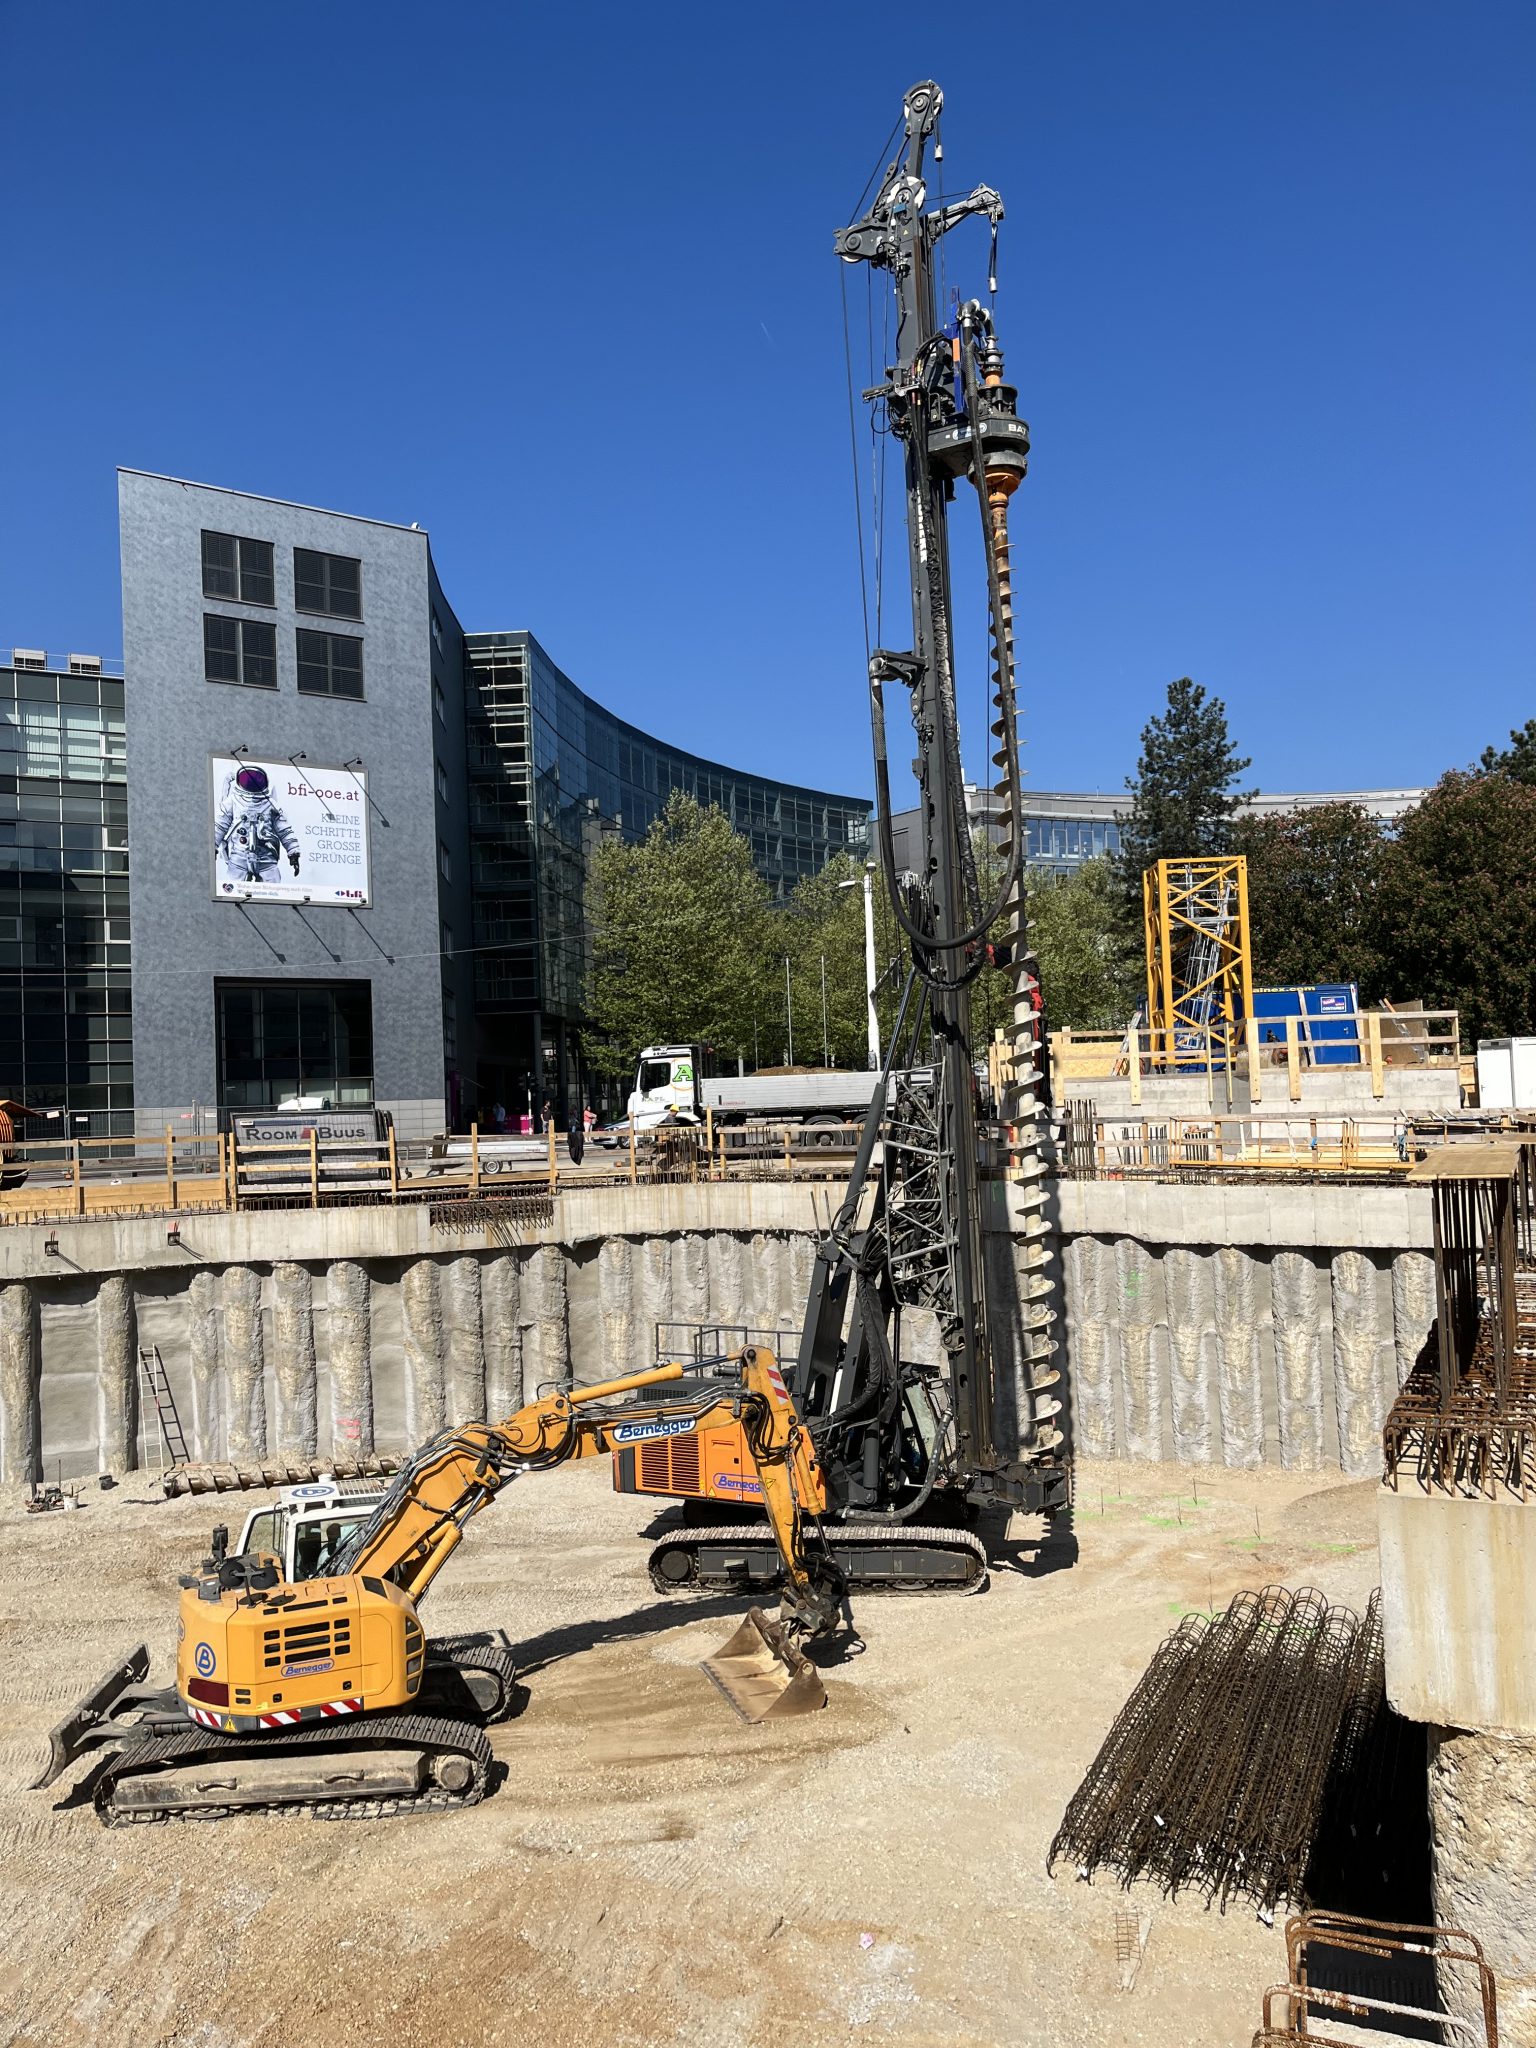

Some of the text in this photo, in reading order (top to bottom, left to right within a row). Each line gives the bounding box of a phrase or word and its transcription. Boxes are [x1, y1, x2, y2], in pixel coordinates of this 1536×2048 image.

[287, 782, 359, 801] bfi-ooe.at
[321, 813, 360, 826] KLEINE
[305, 825, 361, 839] SCHRITTE
[317, 839, 361, 852] GROSSE
[308, 851, 361, 865] SPRÜNGE
[246, 1126, 366, 1141] ROOM BUUS
[619, 1419, 693, 1439] Bernegger
[718, 1475, 762, 1493] Bernegg
[285, 1661, 332, 1676] Bernegger
